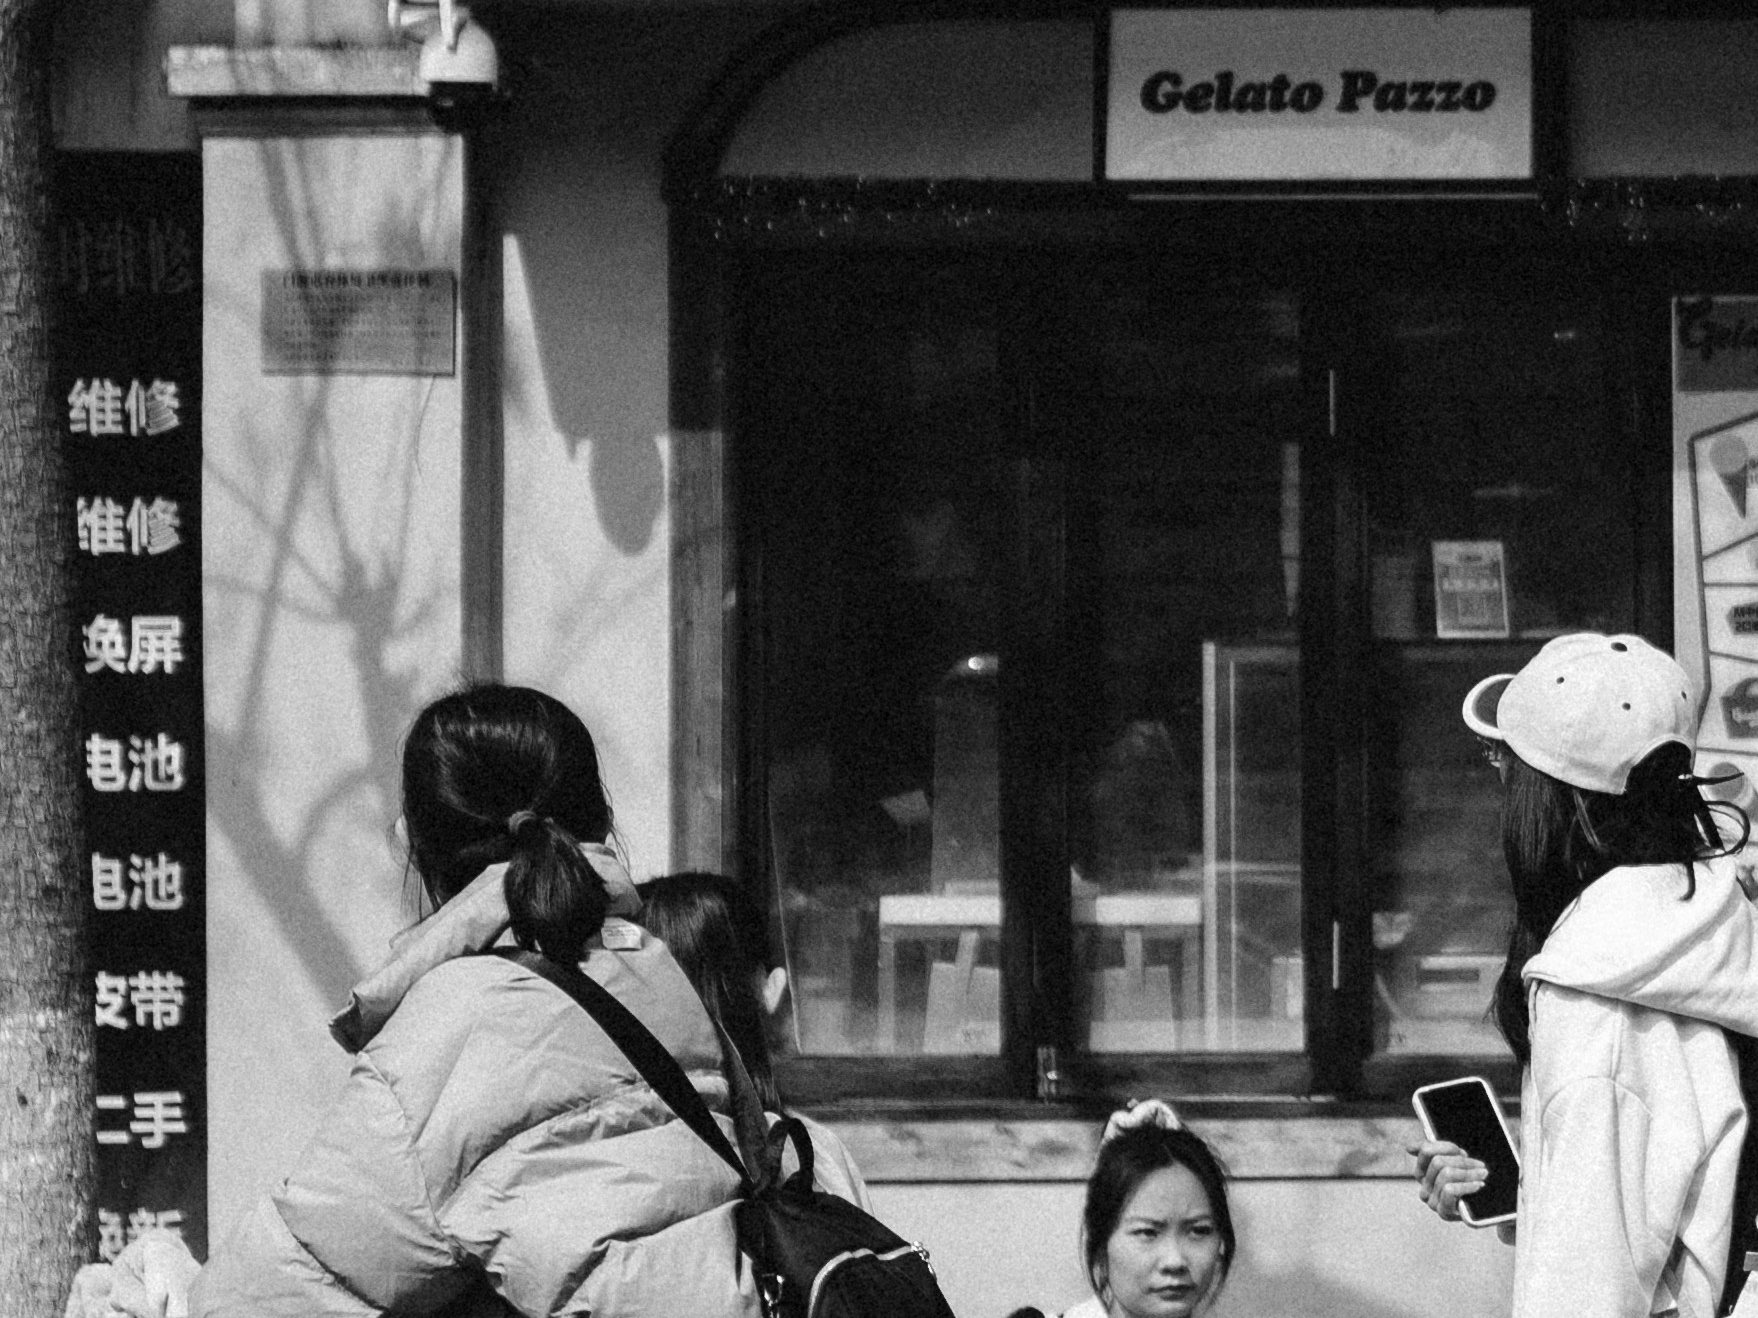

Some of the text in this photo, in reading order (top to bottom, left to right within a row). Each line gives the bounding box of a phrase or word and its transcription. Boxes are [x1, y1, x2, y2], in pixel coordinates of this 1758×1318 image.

[1140, 69, 1497, 114] Gelato Pazzo
[67, 377, 181, 438] 维修
[76, 496, 182, 556] 维修
[86, 732, 184, 791] 电池
[96, 1091, 188, 1148] 二手
